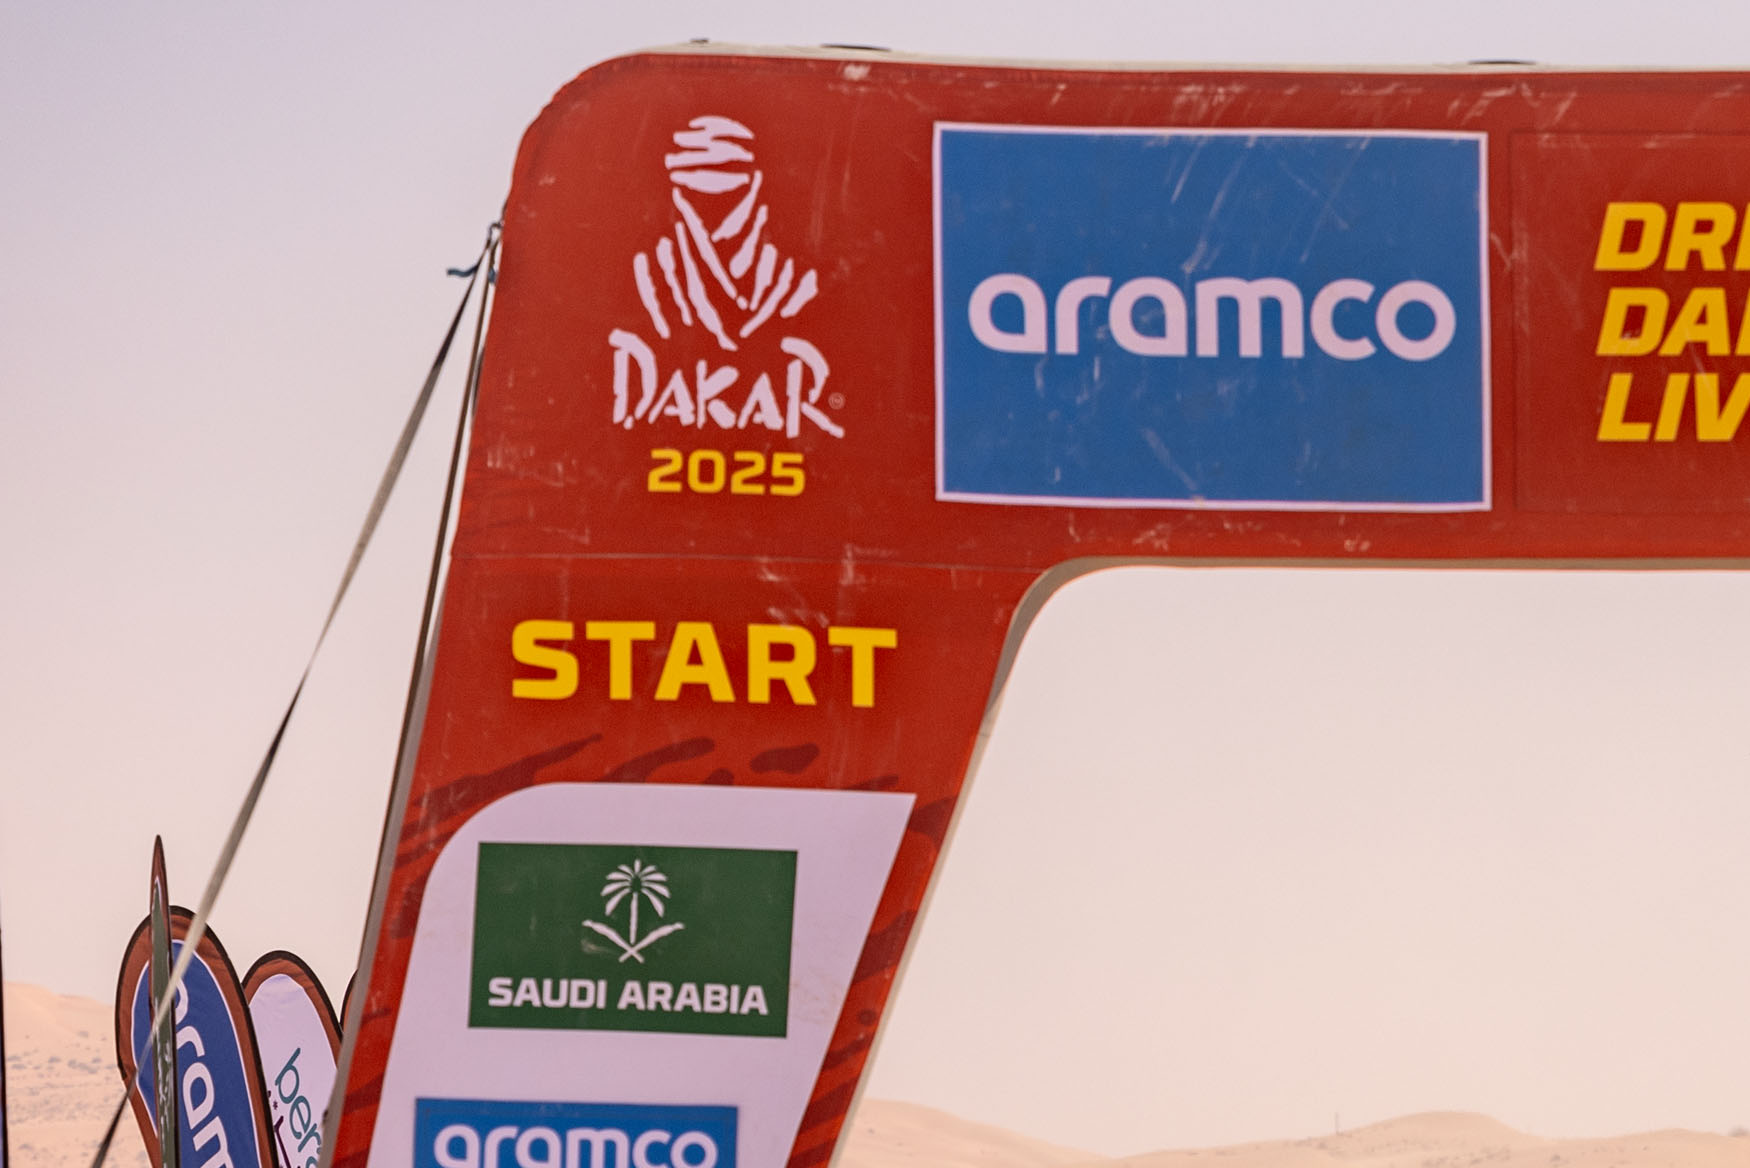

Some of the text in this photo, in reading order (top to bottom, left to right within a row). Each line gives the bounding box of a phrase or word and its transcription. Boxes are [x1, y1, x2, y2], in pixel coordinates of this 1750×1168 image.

[968, 273, 1455, 361] aramco
[608, 329, 845, 438] DAKAR
[647, 449, 806, 496] 2025
[511, 619, 898, 707] START
[488, 977, 769, 1015] SAUDI ARABIA
